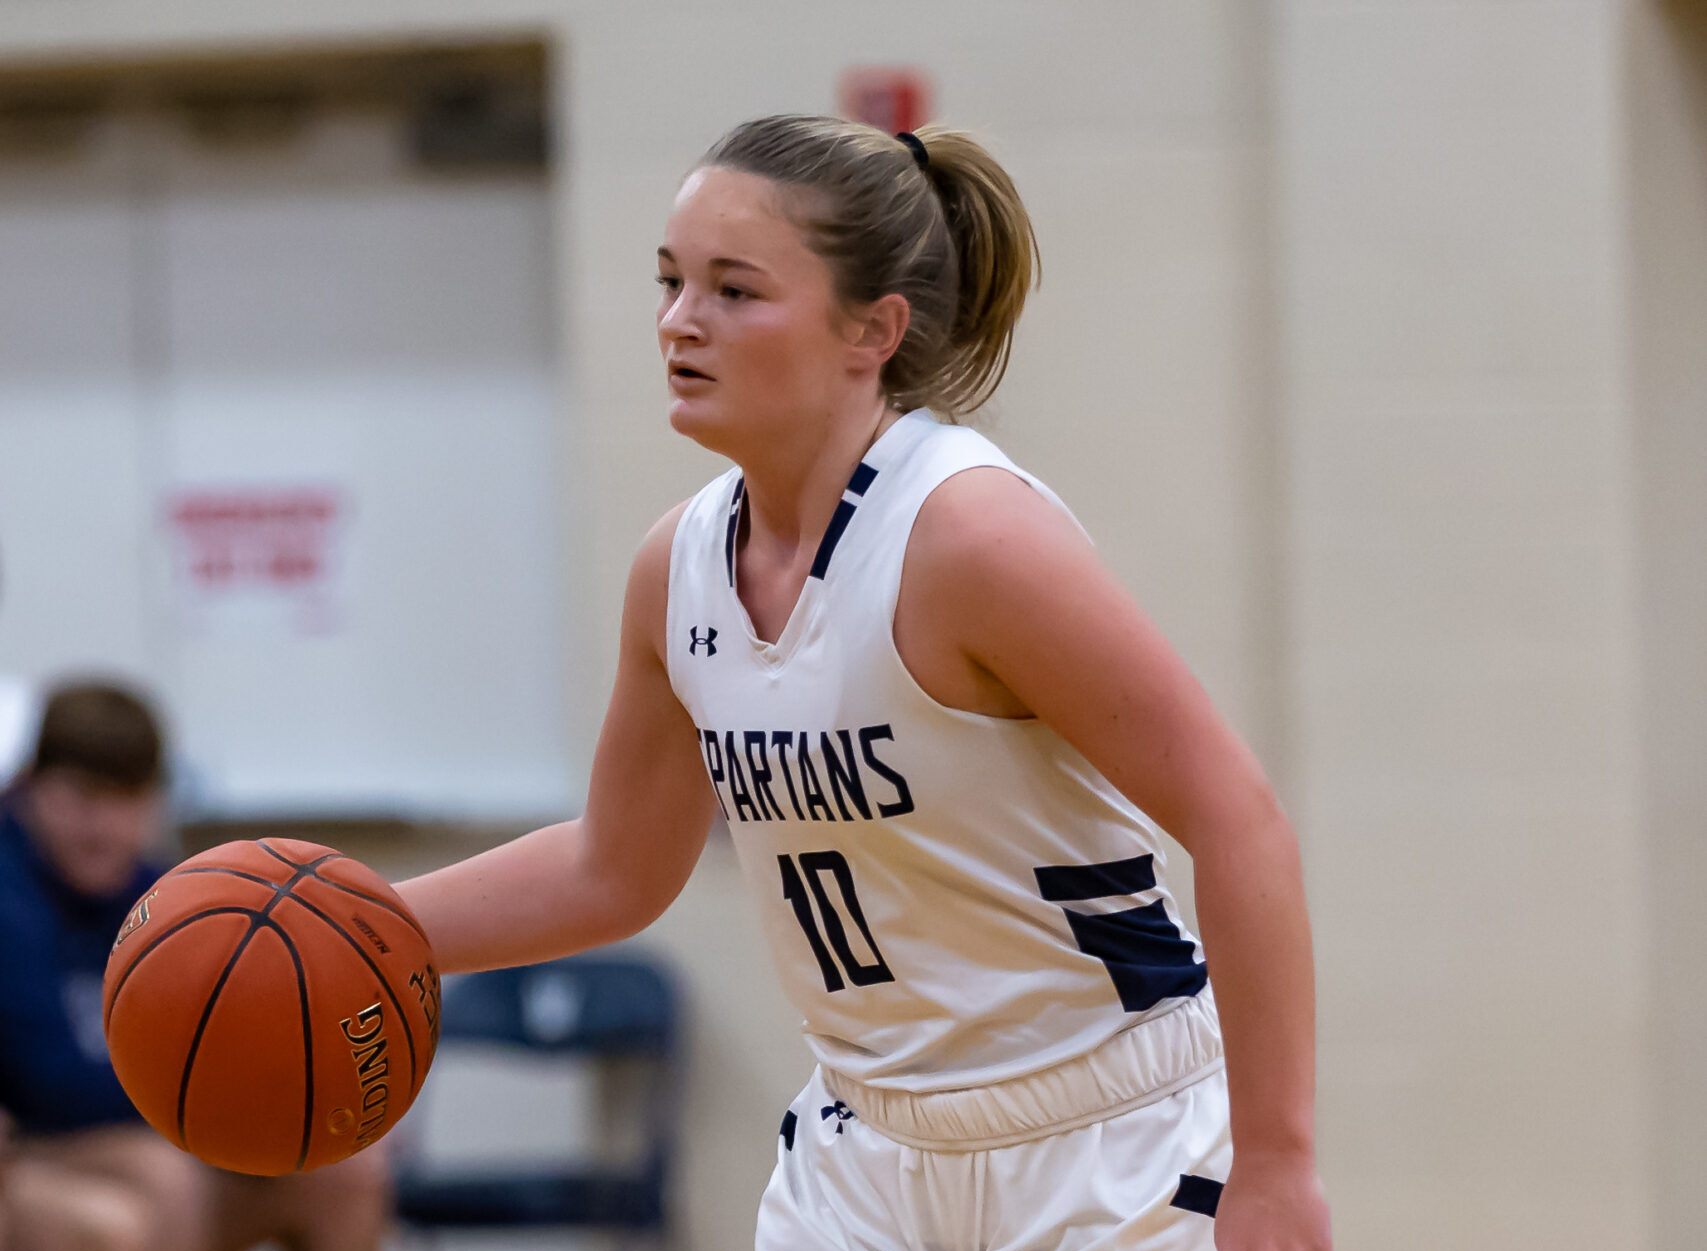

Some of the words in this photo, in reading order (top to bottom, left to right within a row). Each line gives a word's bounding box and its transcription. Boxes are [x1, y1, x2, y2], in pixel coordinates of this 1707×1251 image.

[698, 723, 915, 822] PARTANS
[777, 850, 896, 993] 10
[339, 1001, 390, 1148] ALDING
